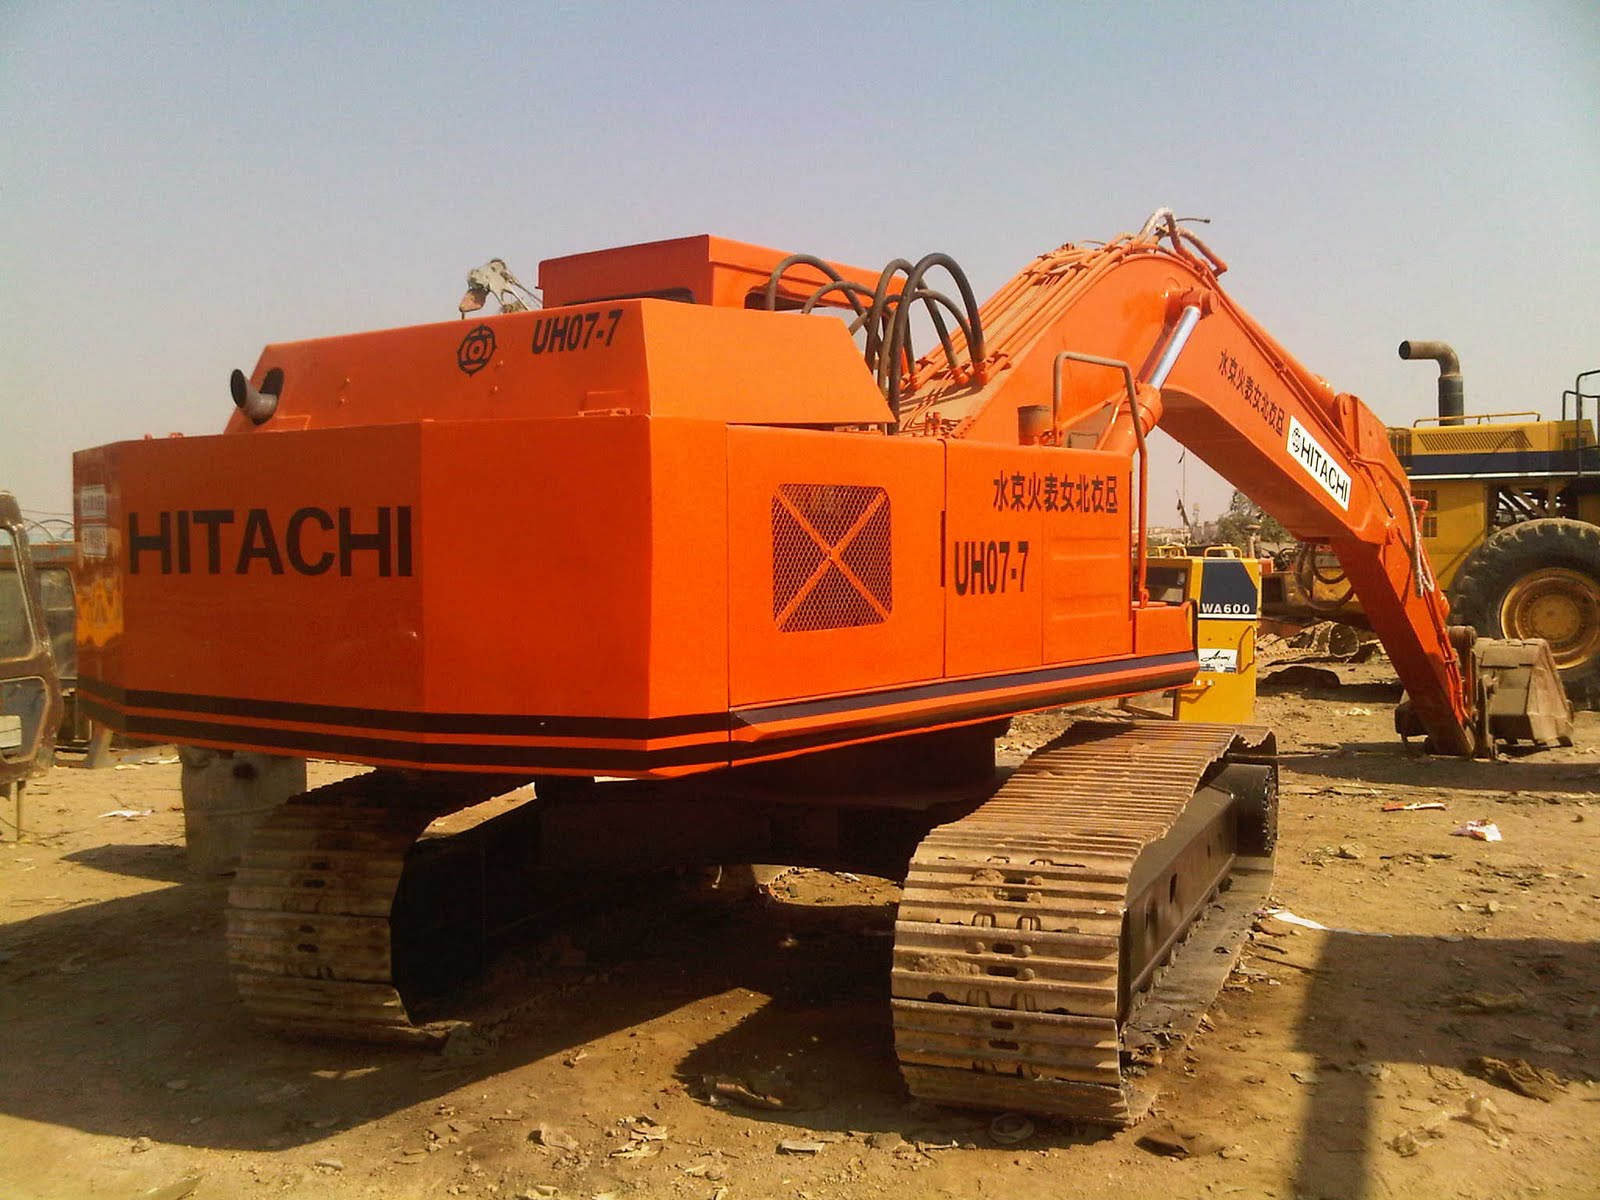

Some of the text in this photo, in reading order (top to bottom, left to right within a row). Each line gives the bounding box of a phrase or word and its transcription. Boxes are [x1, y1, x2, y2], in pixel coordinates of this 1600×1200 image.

[532, 309, 624, 354] UH07-7
[1300, 438, 1349, 503] HITACHI
[128, 505, 413, 578] HITACHI
[954, 540, 1029, 596] UH07-7
[1201, 603, 1251, 614] WA600
